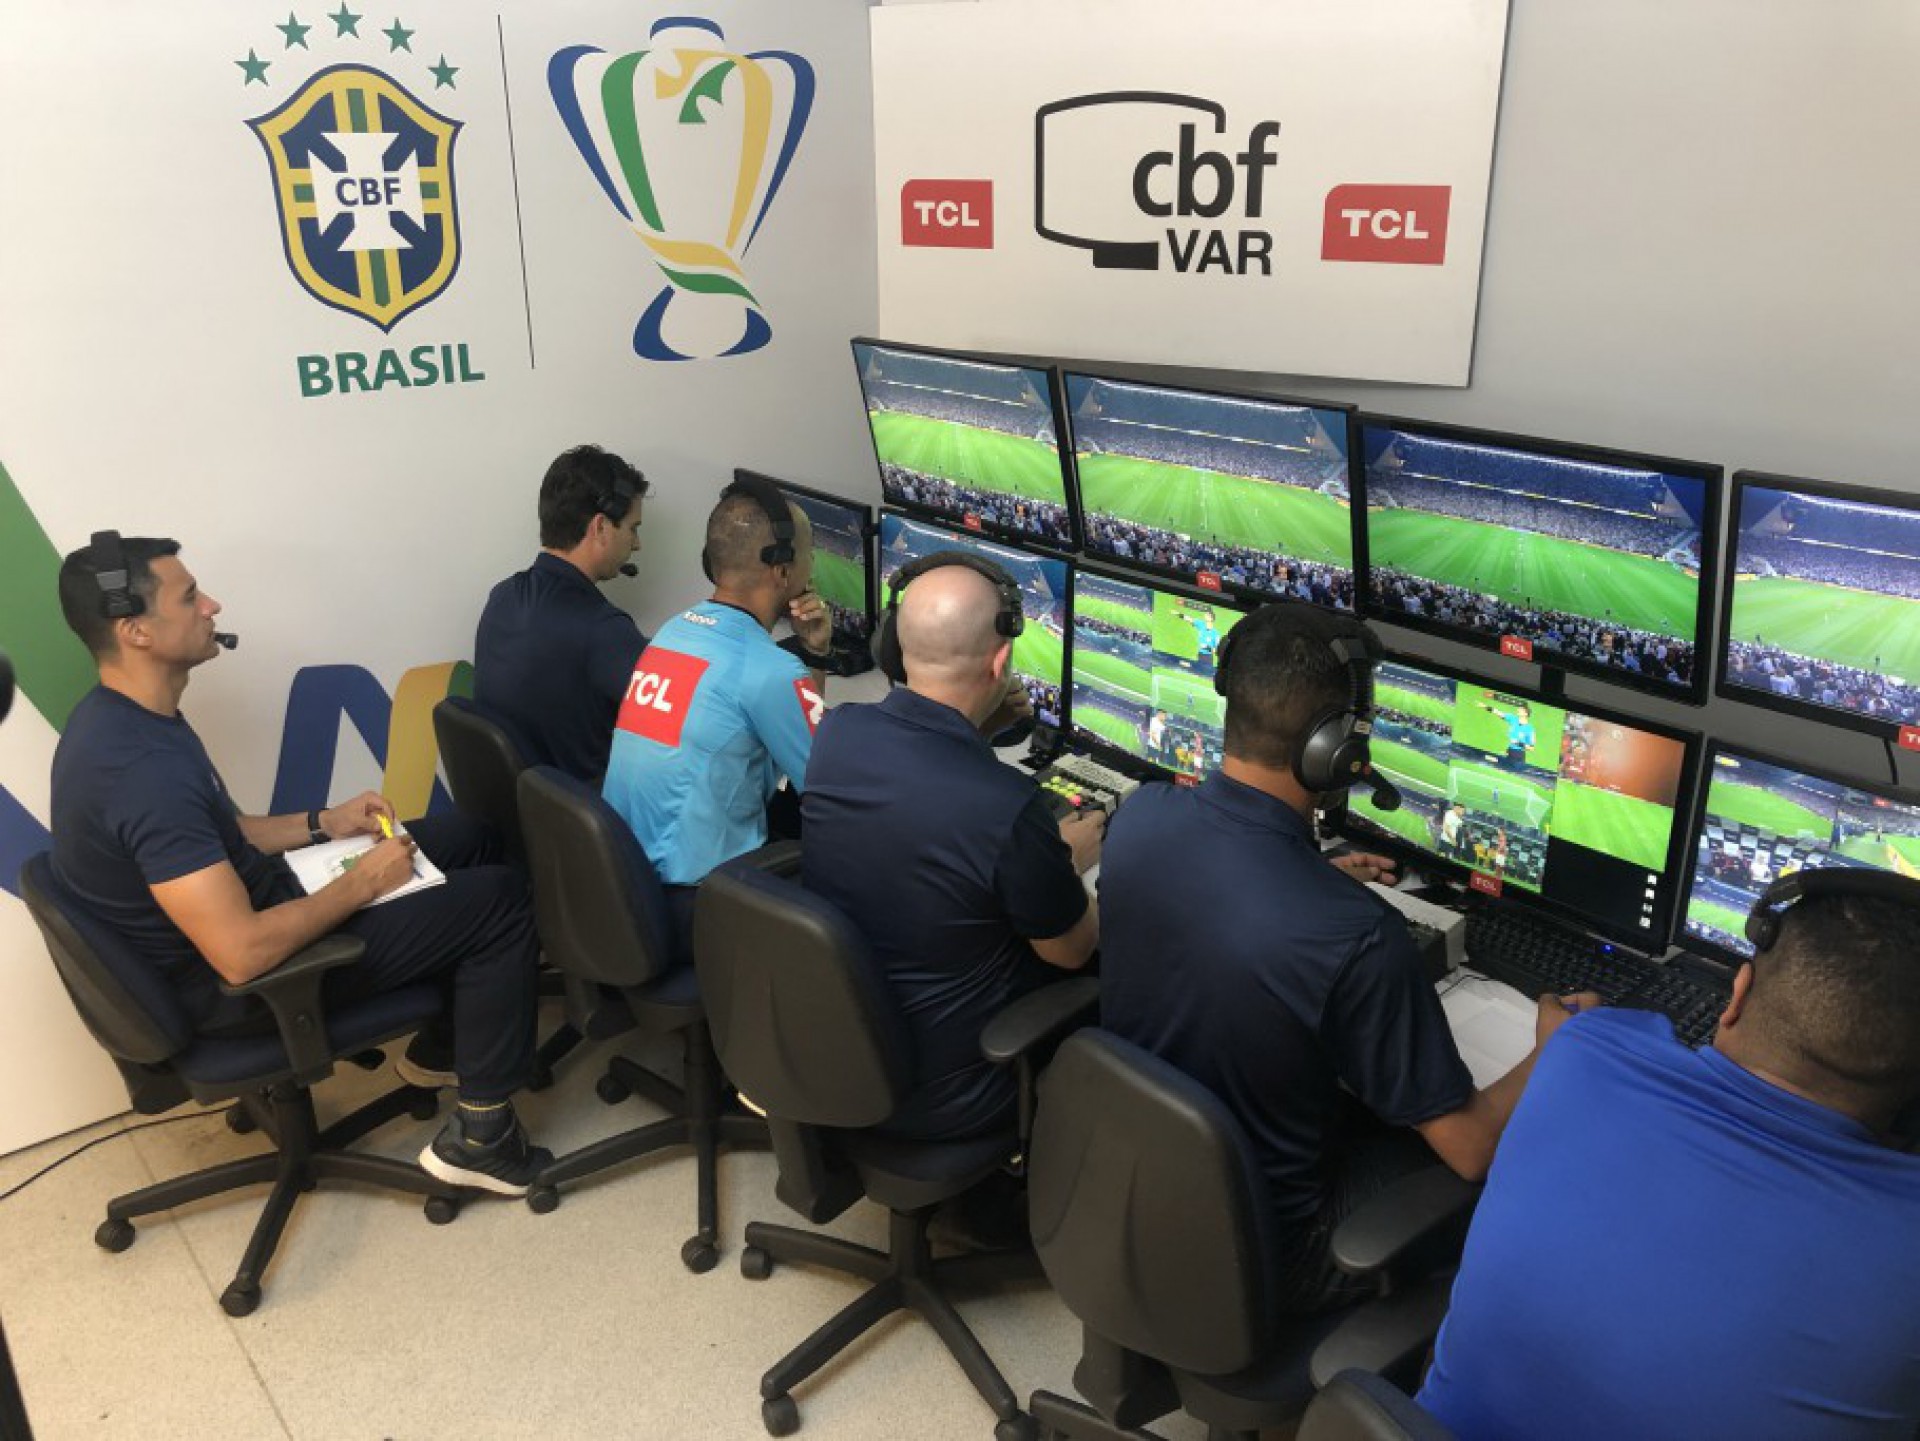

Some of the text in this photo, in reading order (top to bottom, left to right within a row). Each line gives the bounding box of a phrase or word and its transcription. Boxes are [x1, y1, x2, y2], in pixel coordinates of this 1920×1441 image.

[1132, 120, 1281, 218] cbf
[335, 177, 401, 207] CBF
[913, 200, 980, 228] TCL
[1341, 208, 1429, 240] TCL
[1166, 228, 1274, 276] VAR
[297, 343, 485, 398] BRASIL
